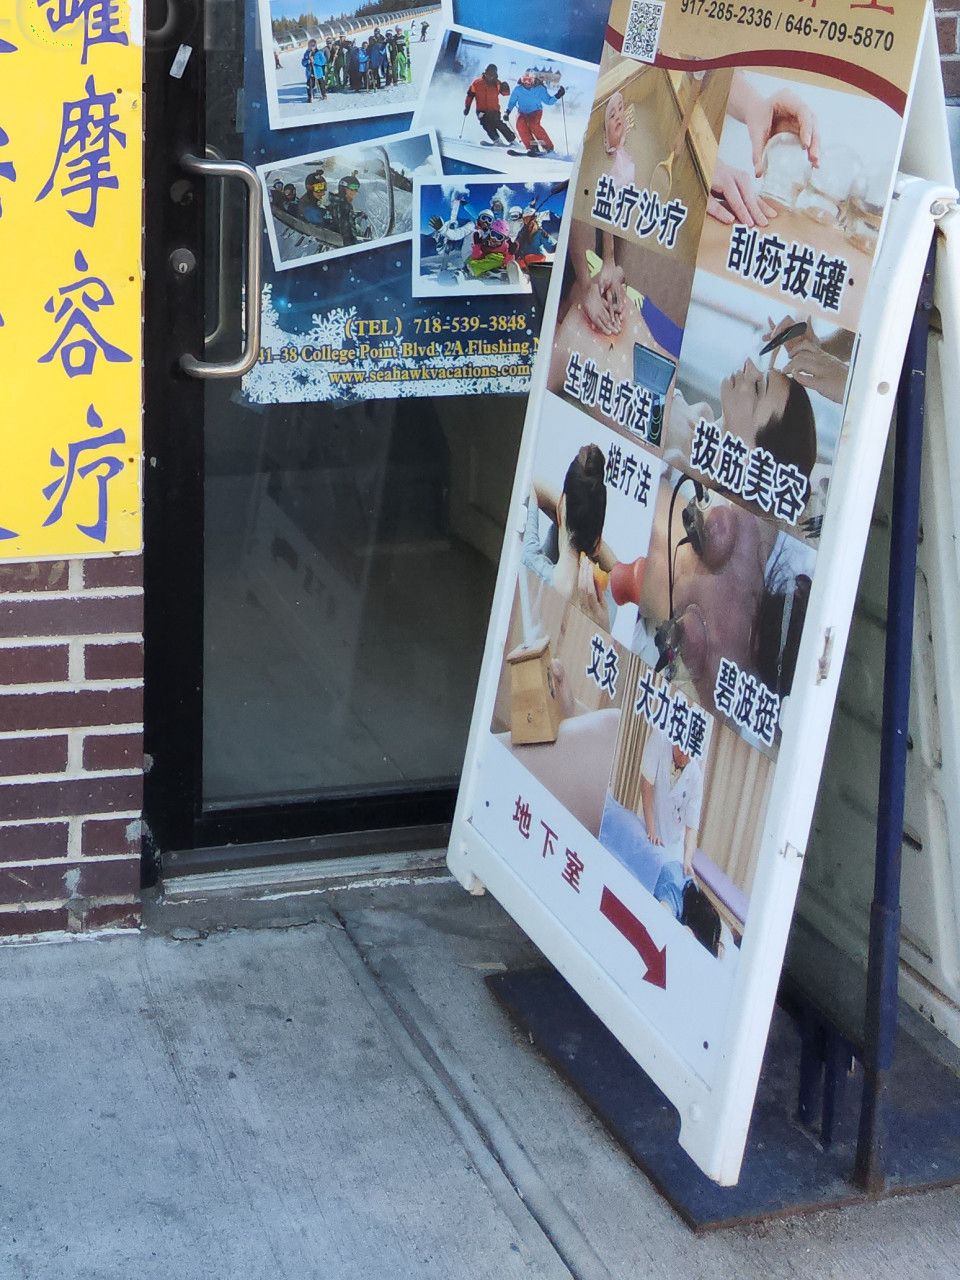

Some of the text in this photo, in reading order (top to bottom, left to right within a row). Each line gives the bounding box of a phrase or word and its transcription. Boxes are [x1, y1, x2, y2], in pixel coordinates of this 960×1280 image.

[785, 13, 894, 52] 646-709-5870
[592, 175, 688, 248] 盐疗沙疗
[727, 226, 849, 312] 刮痧拔罐
[301, 344, 356, 365] College
[360, 343, 398, 361] Point
[414, 314, 526, 335] 718-539-3848
[328, 362, 530, 384] www.seahawkvacations.com
[564, 352, 653, 437] 生物电疗法
[587, 635, 619, 697] 艾灸
[636, 671, 709, 757] 大力按摩
[512, 795, 585, 893] 地下室
